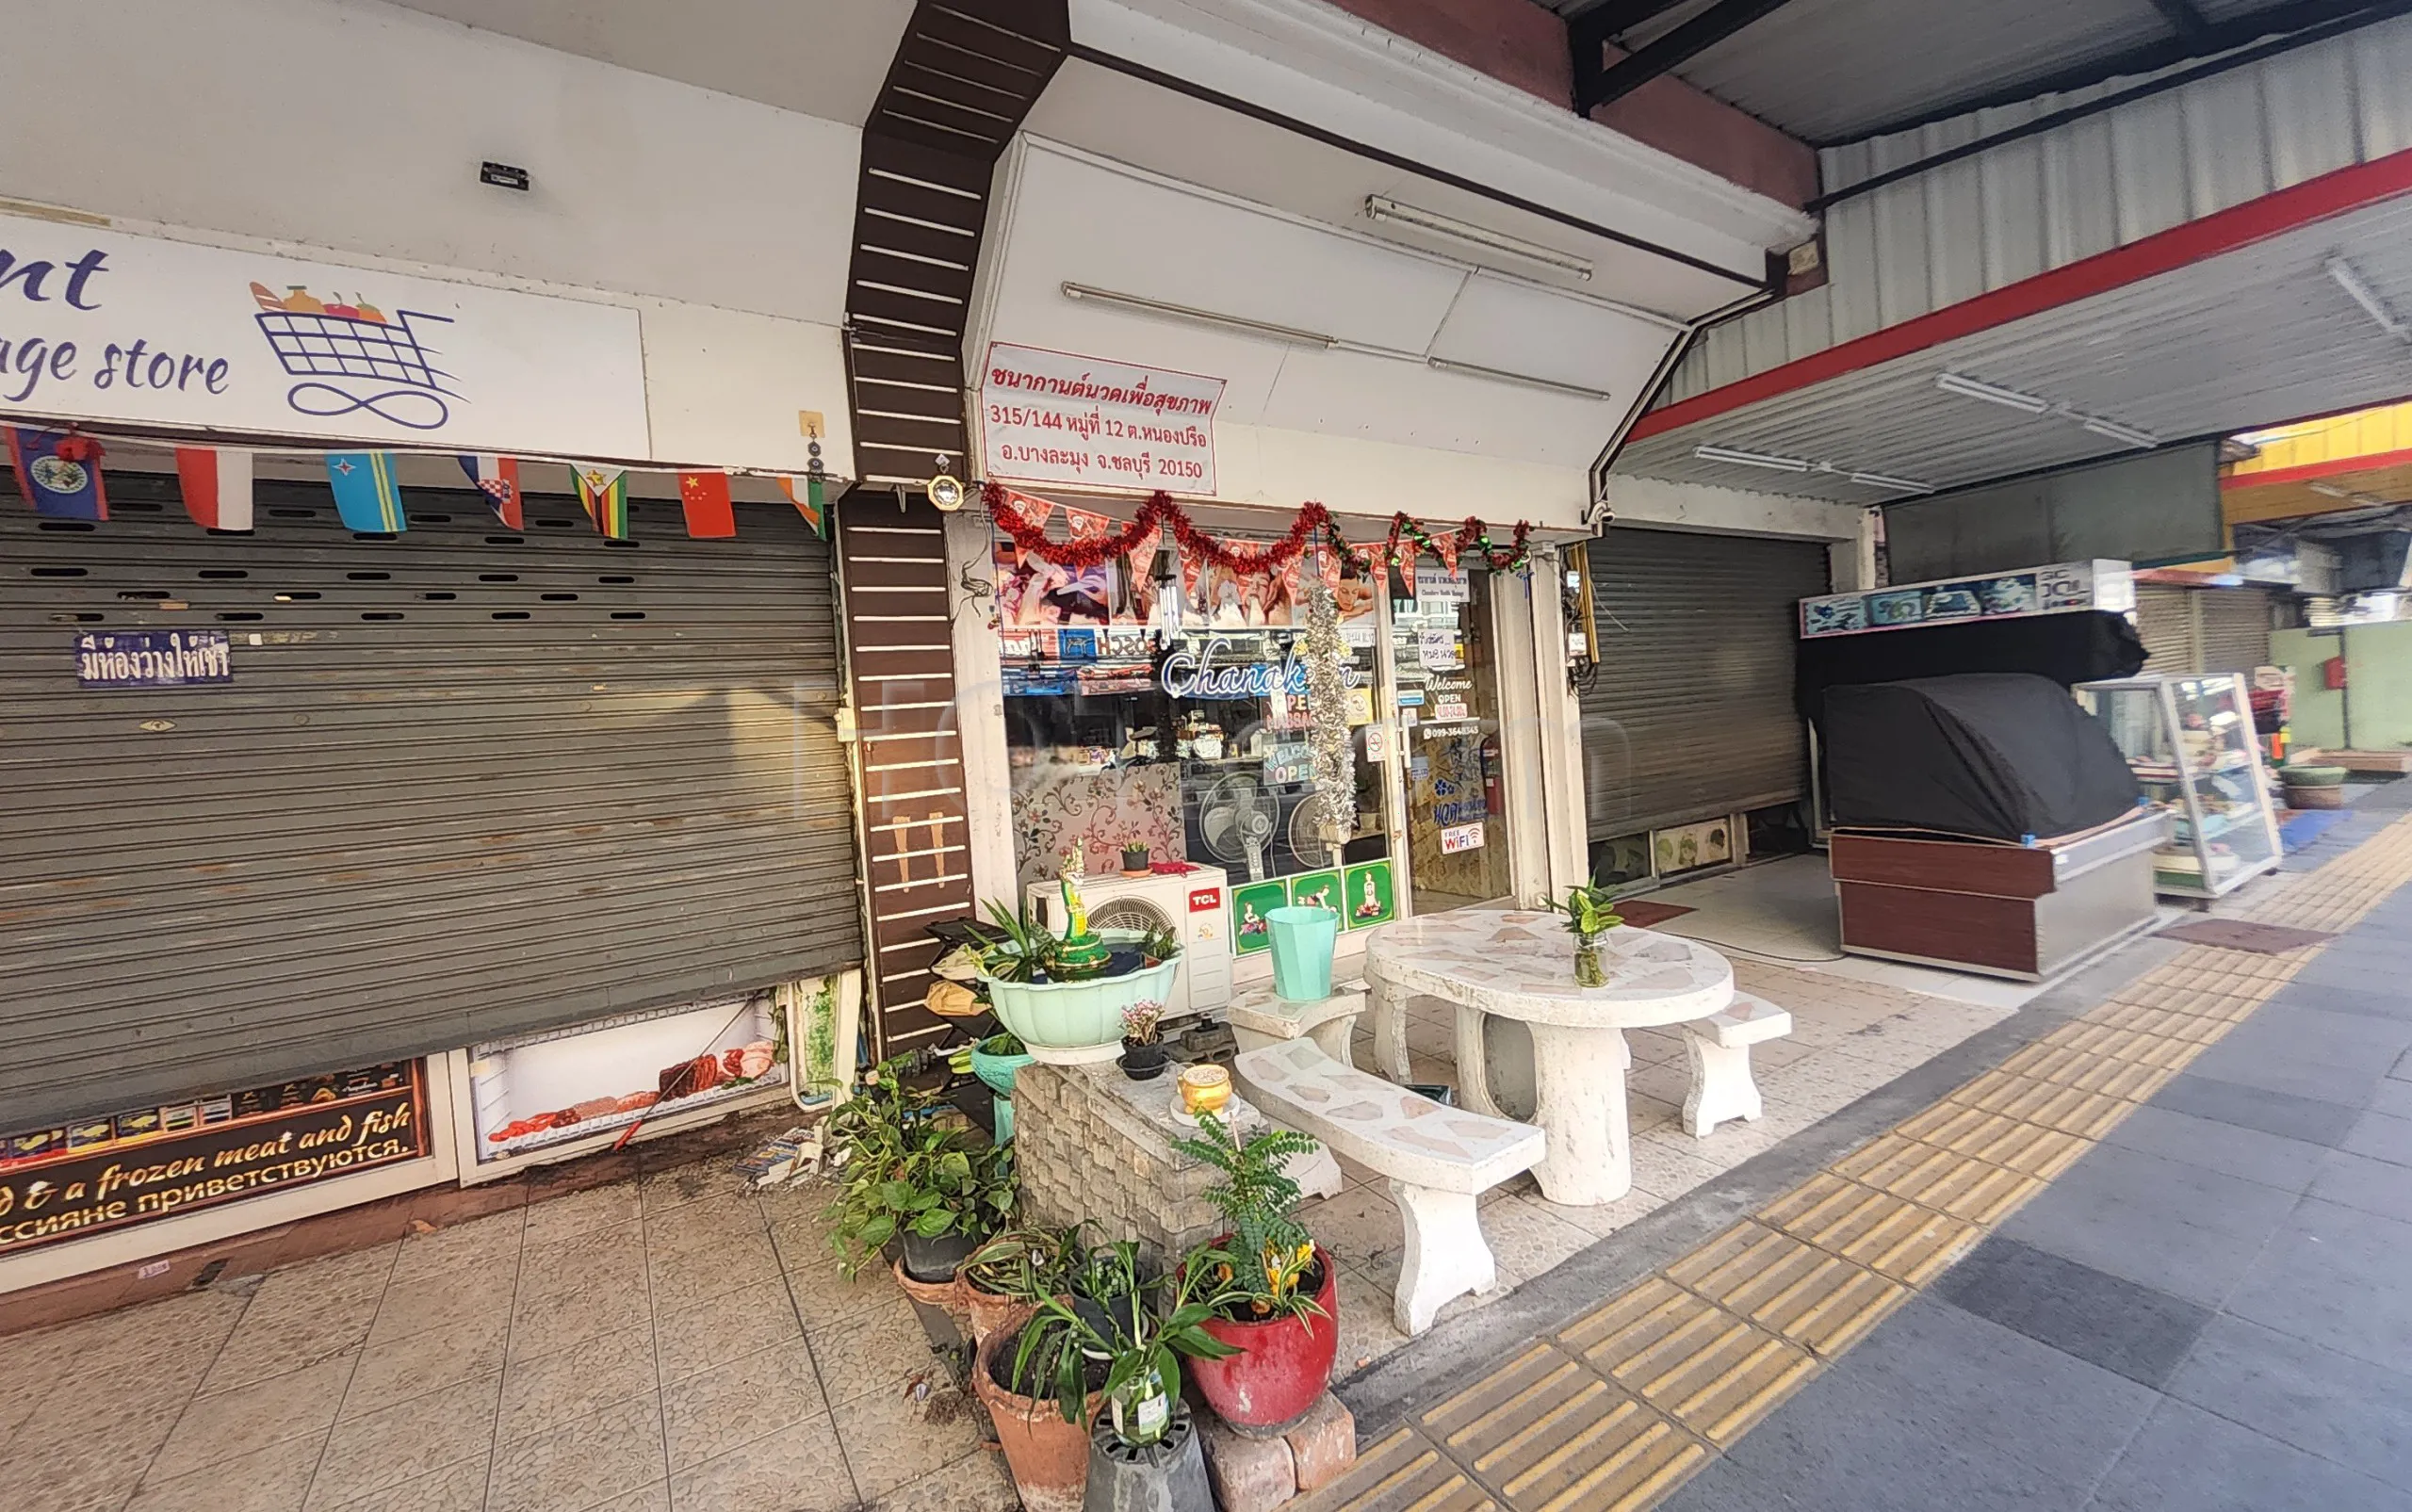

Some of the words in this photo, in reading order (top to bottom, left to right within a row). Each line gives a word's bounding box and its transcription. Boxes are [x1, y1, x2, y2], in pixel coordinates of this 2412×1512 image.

[94, 338, 229, 395] store
[991, 367, 1213, 416] ชนากานต์นวดเพื่อสุขภาพ
[990, 404, 1063, 431] 315/144
[1066, 405, 1100, 441] หมู่ที่
[1105, 419, 1124, 438] 12
[1127, 425, 1207, 447] ต.หนองปรือ
[1002, 445, 1088, 474] อ.บางละมุง
[1097, 451, 1149, 480] จ.ชลบุรี
[1158, 459, 1203, 479] 20150
[1424, 674, 1473, 691] Welcome
[1437, 693, 1462, 704] OPEN
[1444, 830, 1459, 838] FREE
[1192, 894, 1217, 906] TCL
[64, 1181, 87, 1202] a
[96, 1155, 205, 1201] frozen
[214, 1131, 294, 1168] meat
[299, 1114, 352, 1149] and
[350, 1101, 412, 1147] fish
[138, 1138, 409, 1213] приветствуются.
